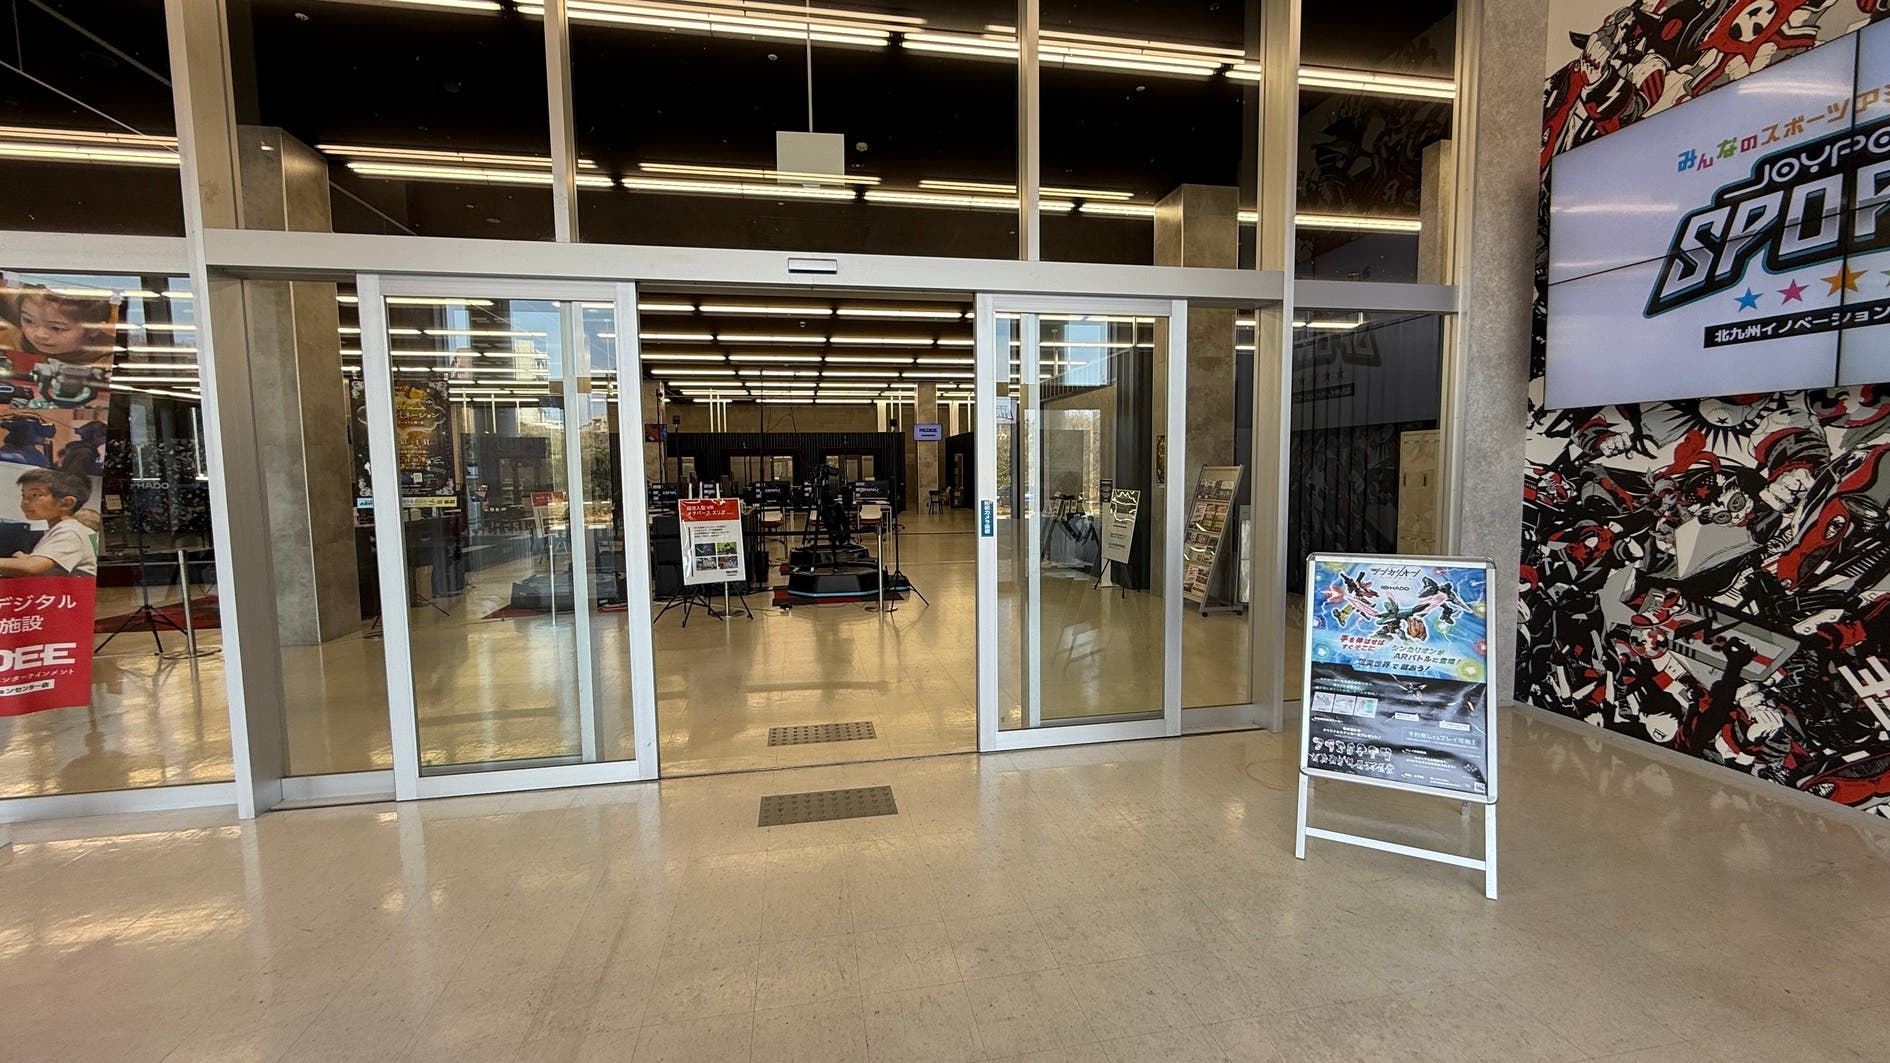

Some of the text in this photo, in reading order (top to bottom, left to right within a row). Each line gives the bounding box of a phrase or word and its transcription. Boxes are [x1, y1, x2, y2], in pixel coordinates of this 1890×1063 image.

[1677, 84, 1890, 173] みんなのスポーツア
[1714, 305, 1890, 343] 北九州イノベーション
[0, 594, 77, 612] デジタル
[0, 615, 44, 634] 施設
[1340, 634, 1386, 646] 手を伸ばせば
[1342, 644, 1376, 652] すぐそこに
[1392, 645, 1445, 655] シンカリオンが
[0, 669, 75, 684] ンターテインメント
